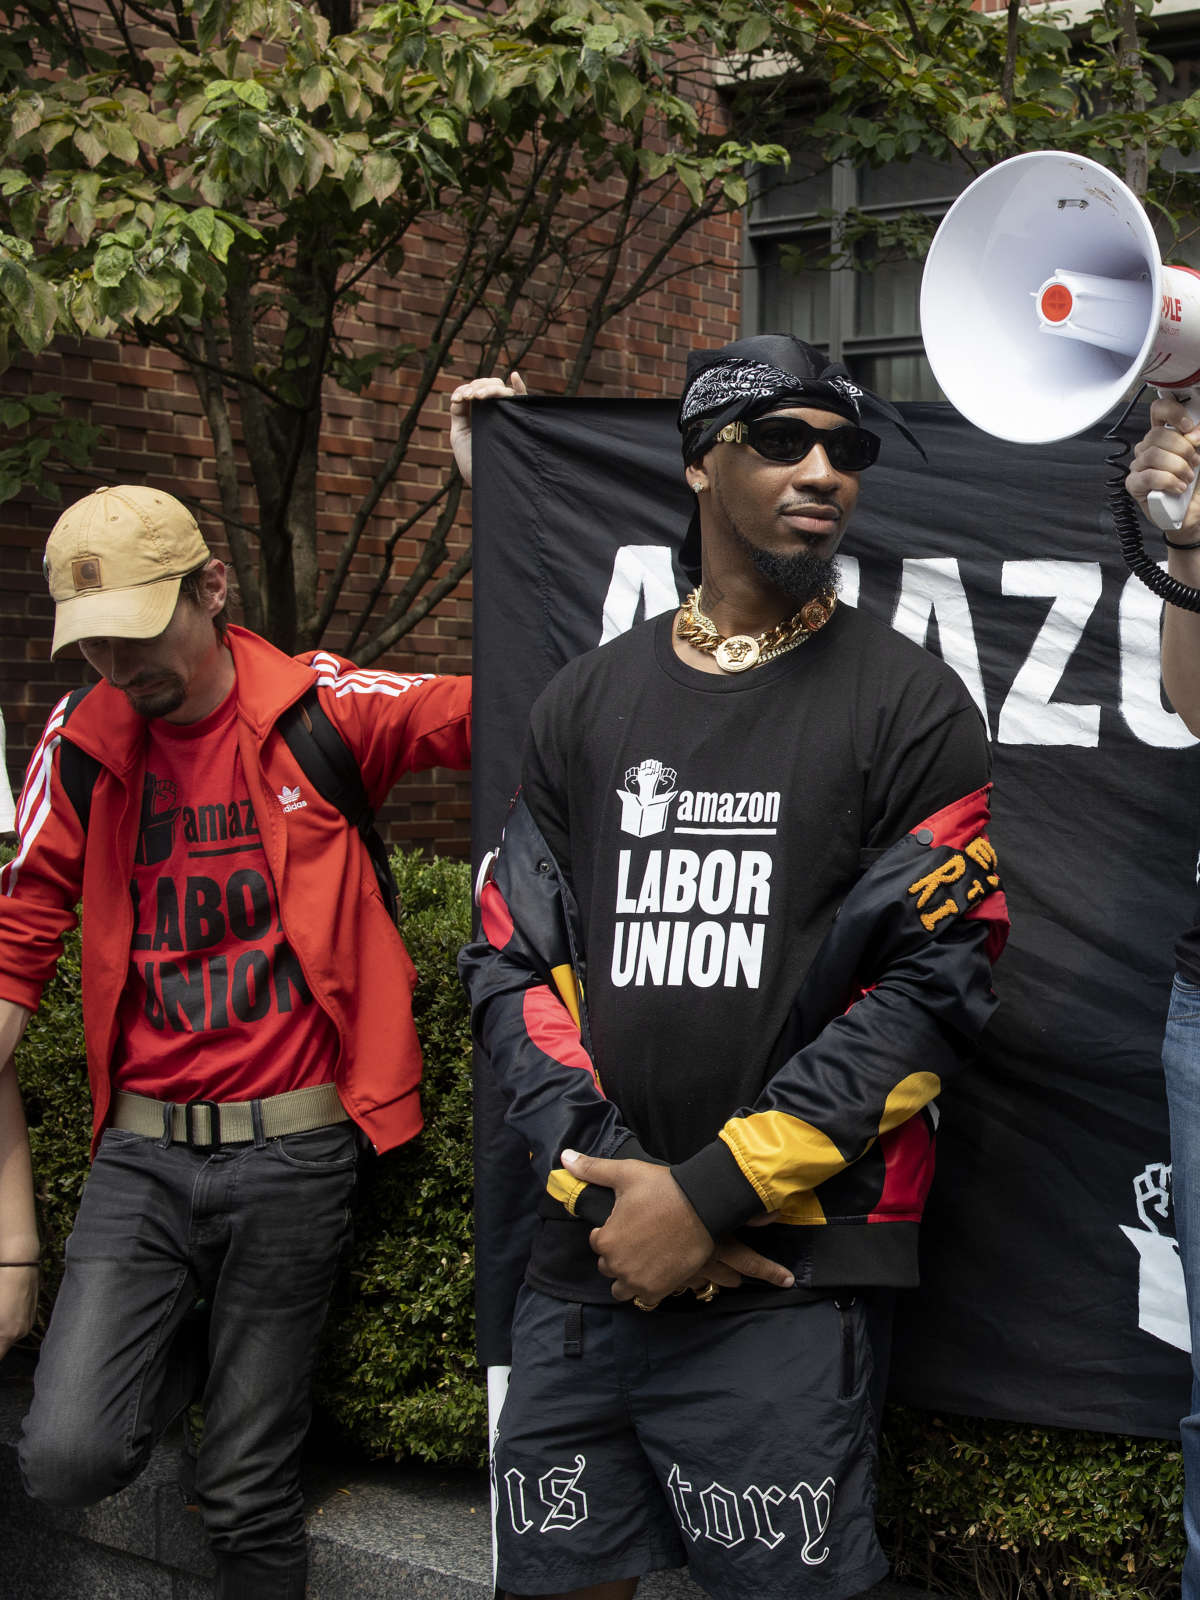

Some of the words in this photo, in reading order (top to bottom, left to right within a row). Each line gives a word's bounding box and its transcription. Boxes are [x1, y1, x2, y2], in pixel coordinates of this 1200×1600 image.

[183, 800, 260, 843] amaz
[283, 800, 308, 814] adidas
[676, 790, 781, 823] amazon
[130, 869, 285, 952] LABO
[615, 849, 773, 916] LABOR
[610, 921, 766, 989] UNION
[667, 1463, 836, 1566] tory
